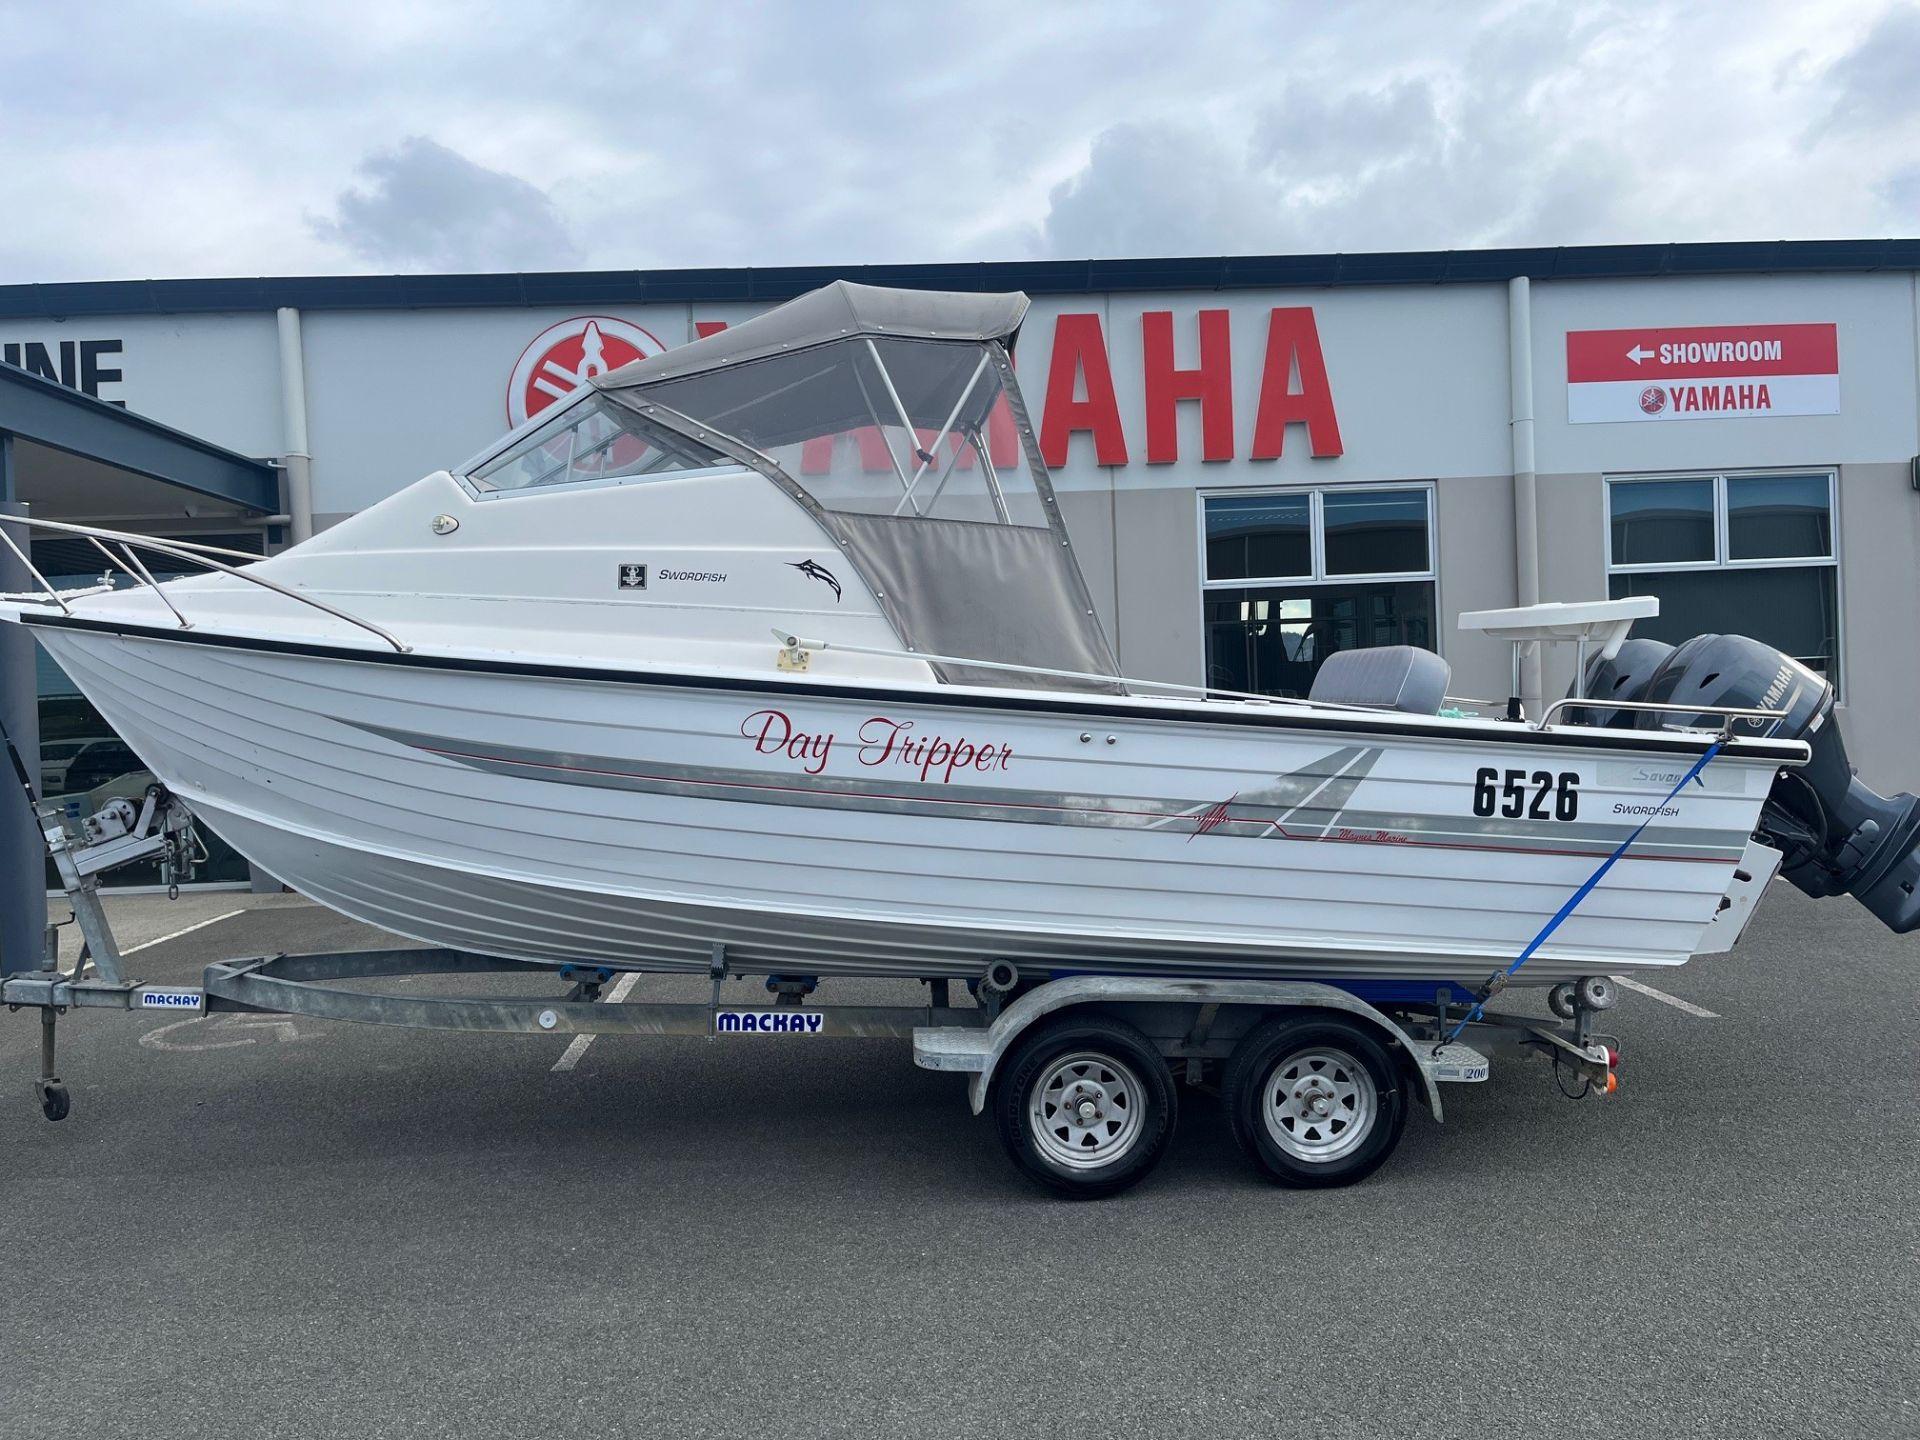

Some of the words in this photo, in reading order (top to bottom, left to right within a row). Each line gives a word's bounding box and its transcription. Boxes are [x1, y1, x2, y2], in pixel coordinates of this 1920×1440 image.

[1659, 340, 1782, 365] SHOWROOM
[1669, 384, 1772, 412] YAMAHA
[658, 569, 727, 582] SWORDFISH
[740, 709, 834, 775] Day
[858, 717, 1013, 783] Tripper
[1472, 767, 1580, 821] 6526
[1612, 803, 1680, 817] SWORDFISH
[144, 994, 199, 1006] MACKAY
[718, 1013, 821, 1032] MACKAY
[1008, 1056, 1040, 1148] ROADSTONE
